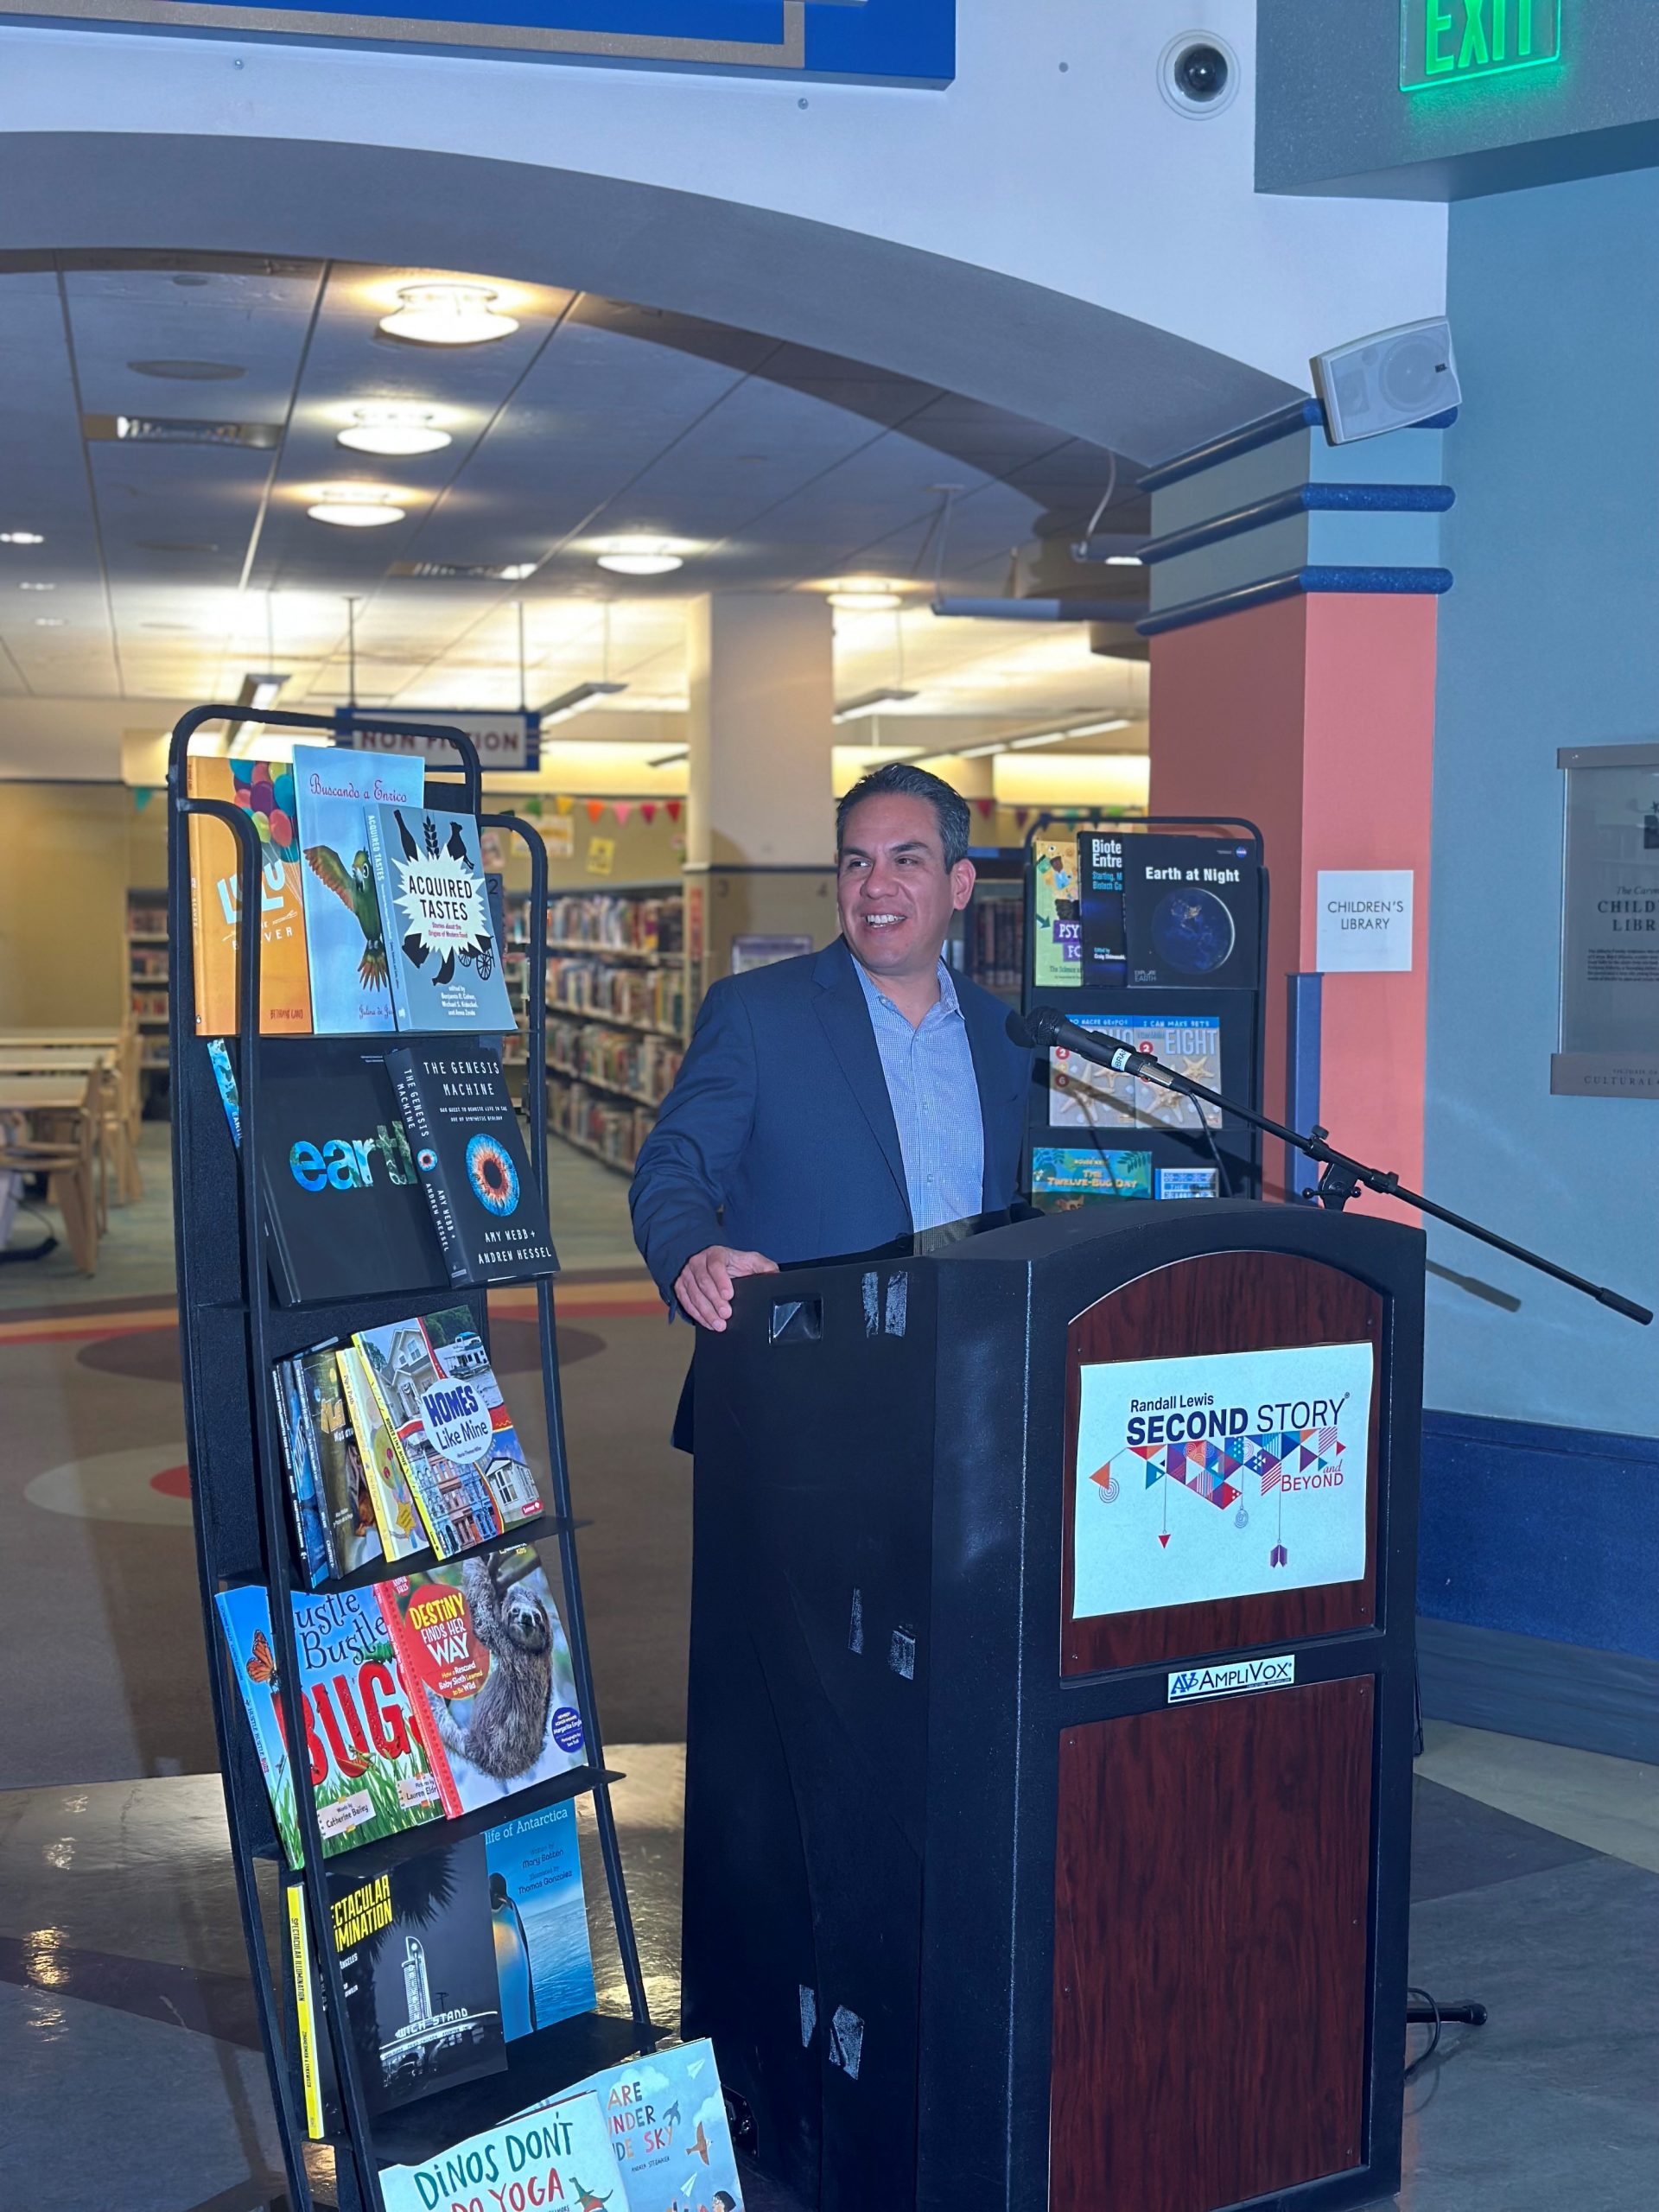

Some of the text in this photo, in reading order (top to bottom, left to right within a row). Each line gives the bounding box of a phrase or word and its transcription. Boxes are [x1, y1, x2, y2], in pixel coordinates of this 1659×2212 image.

[1426, 0, 1531, 74] EXIT
[310, 772, 407, 803] Buscando a Enrico
[367, 815, 385, 880] ACQUIRED TASTES
[409, 875, 473, 899] ACQUIRED
[1146, 867, 1240, 884] Earth at Night
[420, 899, 467, 921] TASTES
[1327, 900, 1404, 913] CHILDREN'S
[1597, 900, 1659, 913] CHILD
[1341, 918, 1389, 931] LIBRARY
[1167, 1030, 1217, 1055] EIGHT
[423, 1061, 499, 1075] THE GENESIS
[404, 1068, 429, 1137] THE GENESIS
[442, 1083, 494, 1096] MACHINE
[397, 1083, 416, 1129] MACHINE
[437, 1190, 448, 1205] AMY
[425, 1183, 449, 1252] ANDREW HESSEL
[442, 1209, 454, 1231] WEBB
[485, 1230, 501, 1243] AMY
[505, 1229, 528, 1241] WEBB
[478, 1247, 552, 1264] ANDREW HESSEL
[423, 1385, 479, 1427] HOMES
[1130, 1393, 1214, 1413] Randall Lewis
[435, 1420, 488, 1450] Like Mine
[1127, 1408, 1249, 1446] SECOND
[1323, 1459, 1343, 1474] and
[1281, 1472, 1344, 1492] BEYOND
[295, 1594, 359, 1635] ustle
[299, 1611, 388, 1669] Bustle
[420, 1618, 466, 1643] FINDS HER
[427, 1631, 469, 1667] WAY
[270, 1661, 422, 1785] BUG
[326, 1804, 368, 1828] Catherine Bailey
[503, 1823, 513, 1839] of
[517, 1808, 568, 1834] Antarctica
[331, 1874, 391, 1928] CTACULAR
[290, 1917, 305, 2001] SPECTACULAR ILLUMINATION
[433, 2008, 467, 2025] STAND
[607, 2082, 642, 2110] ARE
[505, 2112, 573, 2172] DON'T
[644, 2126, 673, 2154] SKY
[487, 2167, 564, 2212] YOGA
